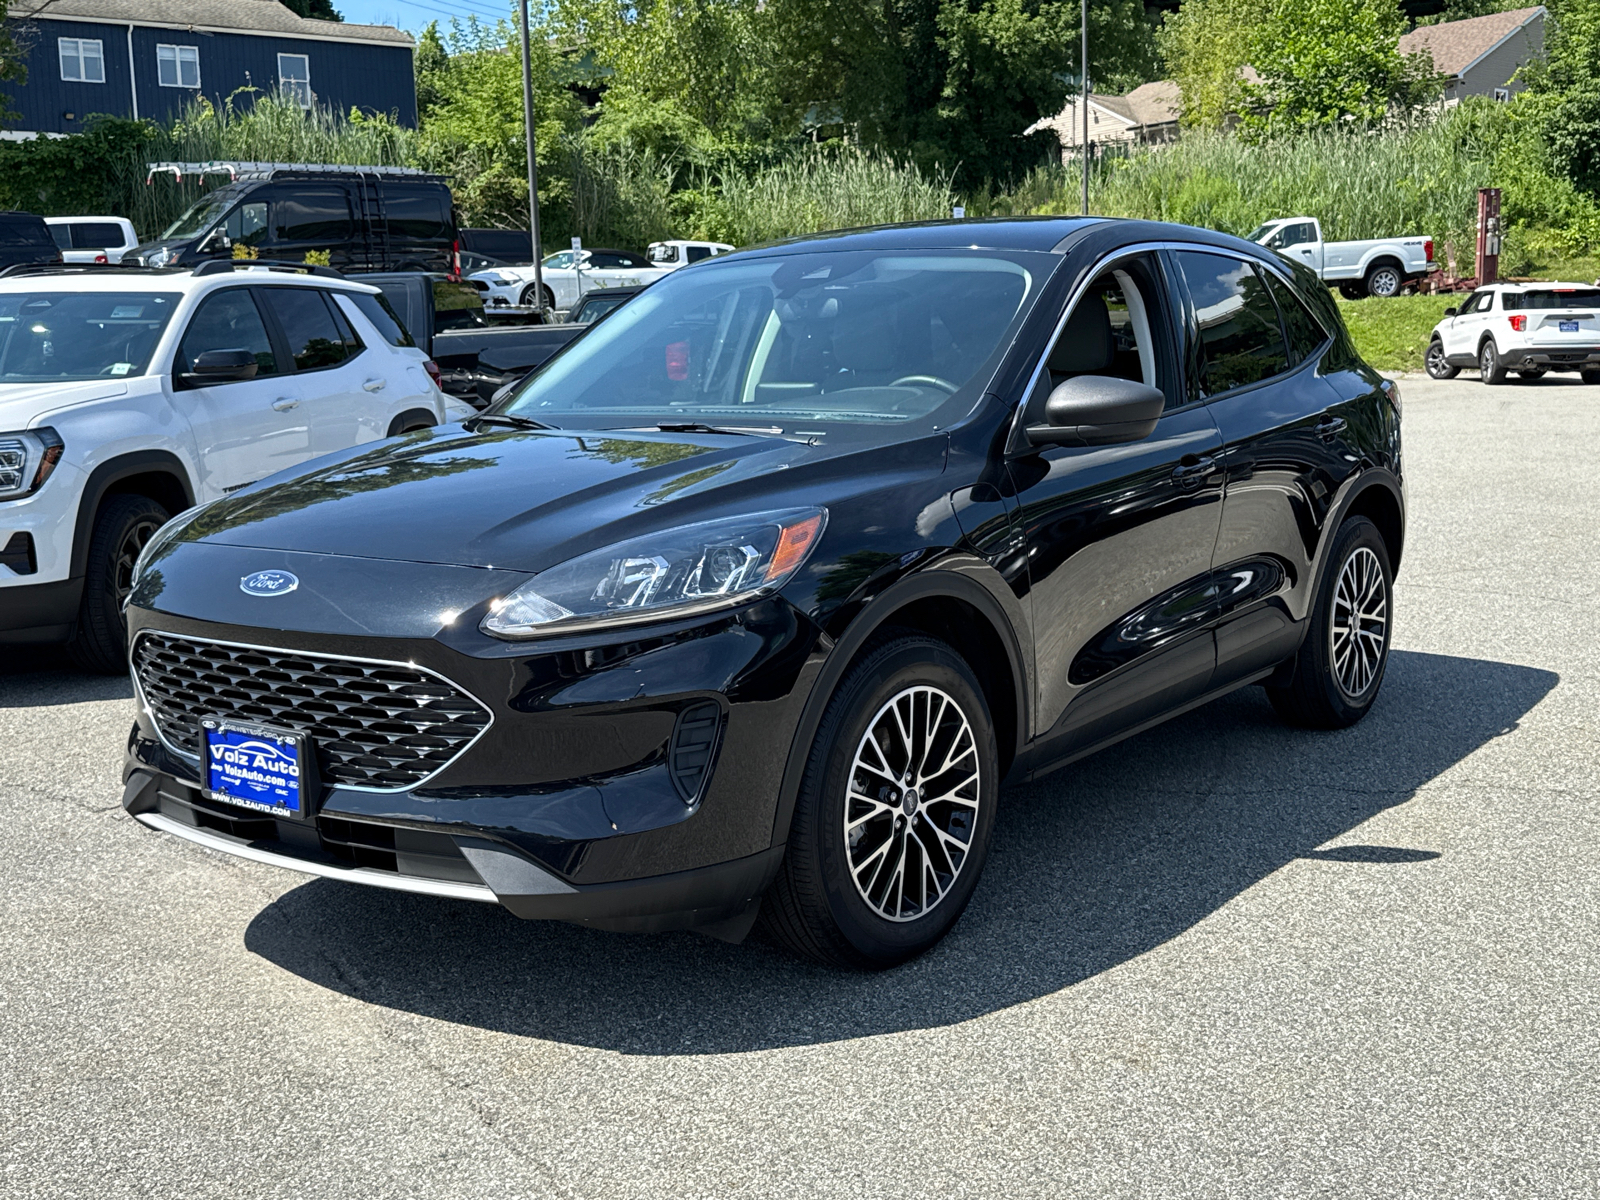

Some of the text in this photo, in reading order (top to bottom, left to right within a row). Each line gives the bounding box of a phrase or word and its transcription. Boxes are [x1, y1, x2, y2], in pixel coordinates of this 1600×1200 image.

[222, 480, 258, 493] TERR
[249, 573, 285, 590] Ford
[210, 744, 300, 777] Volz Auto
[224, 763, 286, 787] VolzAuto.com
